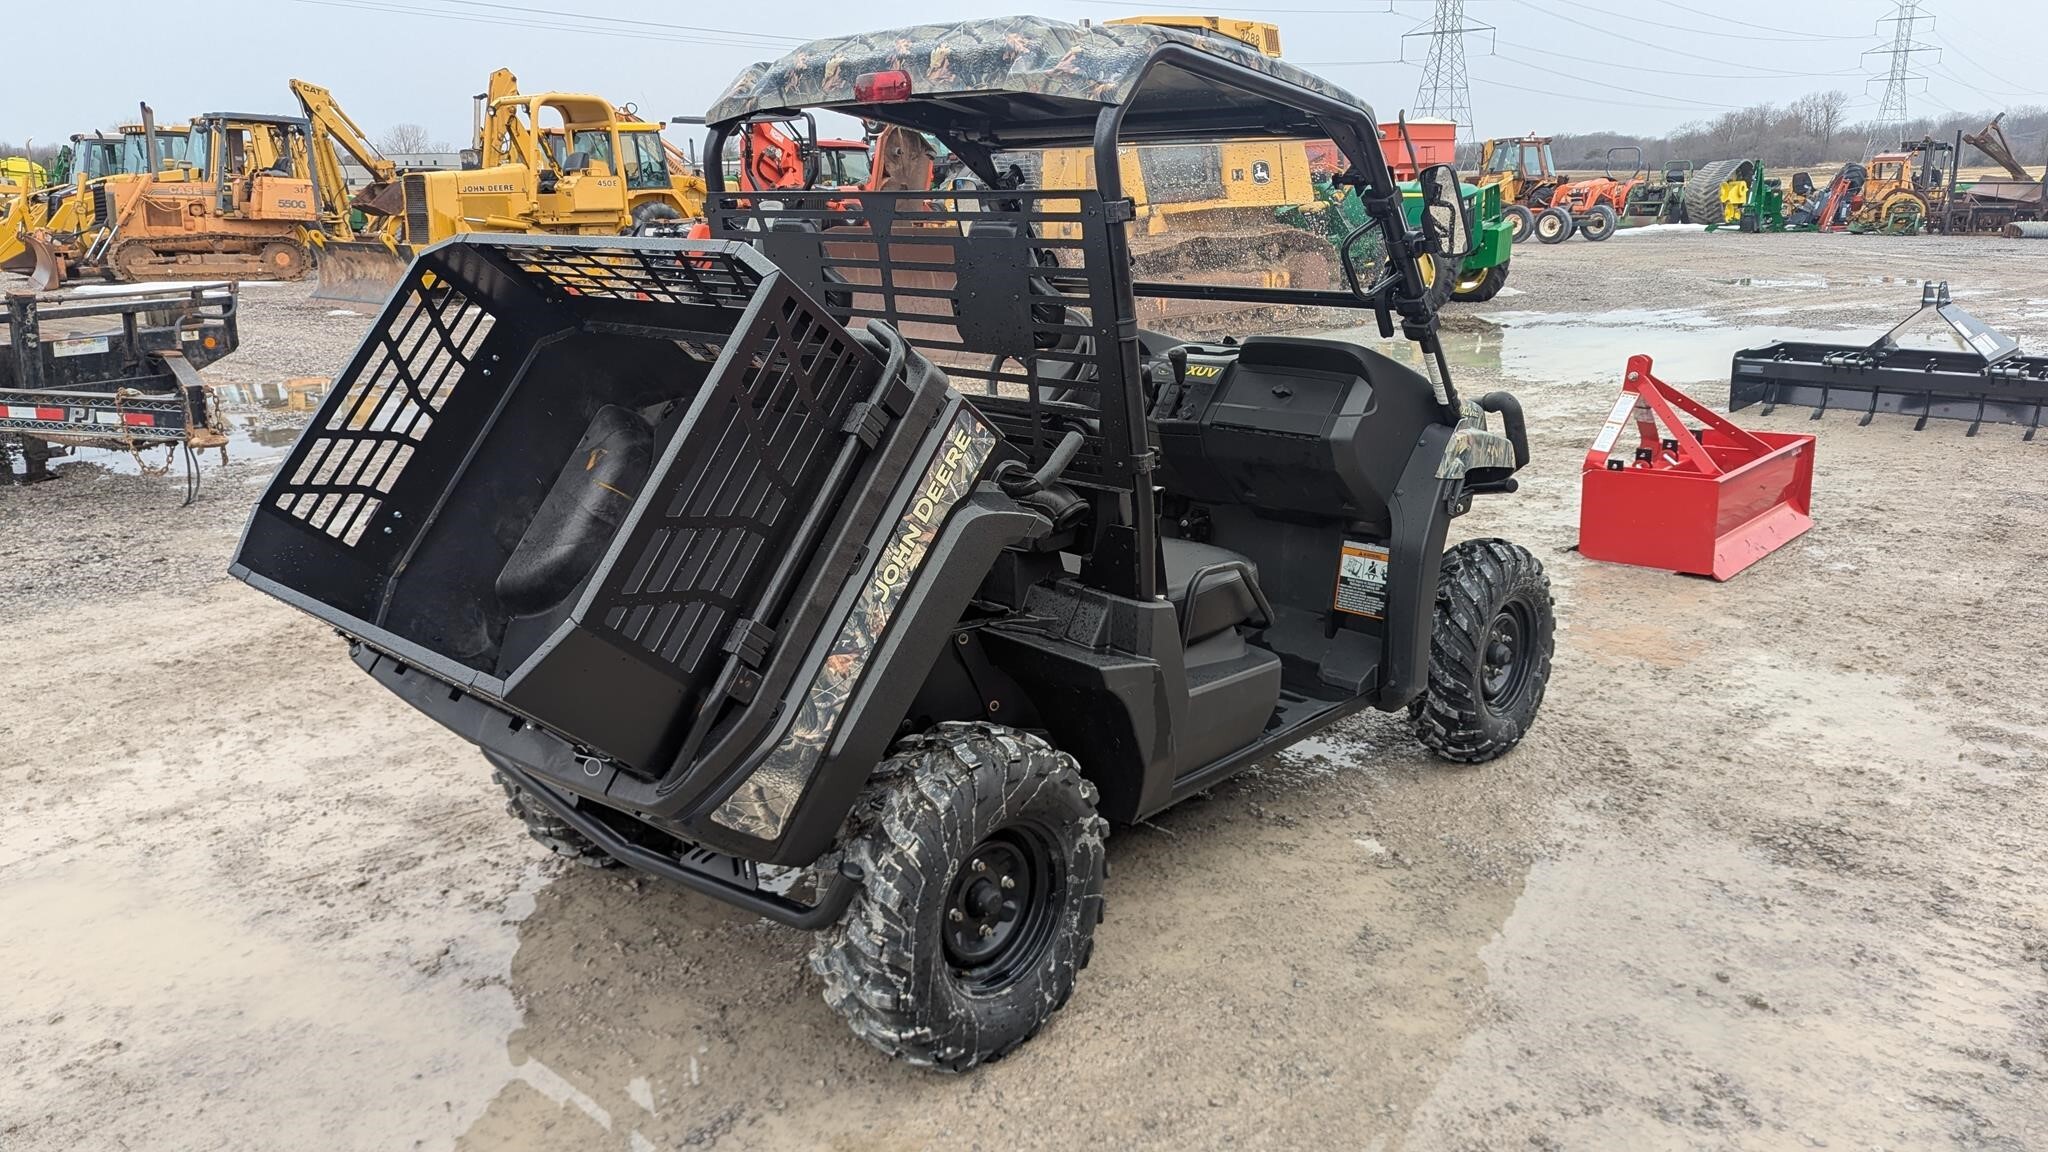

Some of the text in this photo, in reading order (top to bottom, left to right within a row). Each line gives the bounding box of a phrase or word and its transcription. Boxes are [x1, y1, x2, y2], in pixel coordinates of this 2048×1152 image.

[303, 84, 321, 95] CAT
[168, 184, 201, 195] CASE
[463, 184, 514, 193] JOHN DEERE
[278, 199, 307, 209] 550G
[1185, 365, 1220, 378] XUV
[69, 406, 96, 424] PJ
[874, 429, 972, 603] JOHN DEERE
